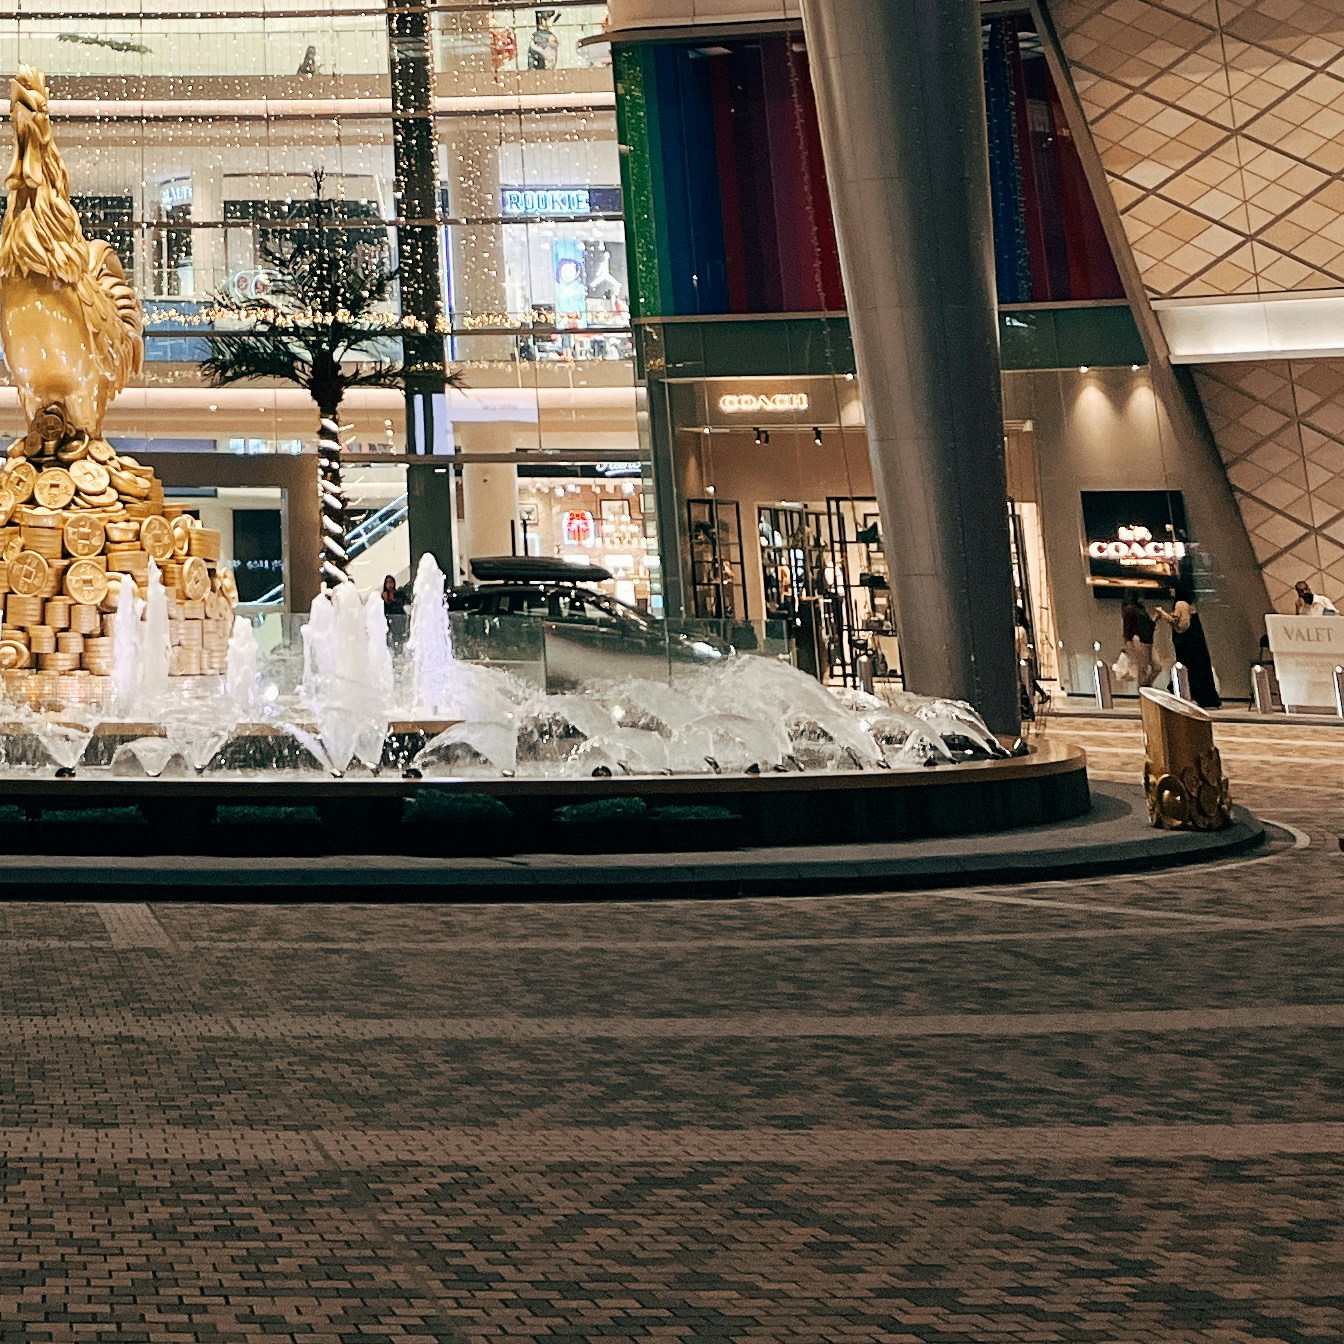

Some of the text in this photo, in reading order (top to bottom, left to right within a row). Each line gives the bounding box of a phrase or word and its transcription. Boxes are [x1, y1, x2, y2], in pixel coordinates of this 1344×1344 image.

[505, 189, 590, 213] ROOKIE
[718, 393, 809, 414] COACH
[1088, 540, 1186, 560] COACH
[1282, 626, 1334, 643] VALET
